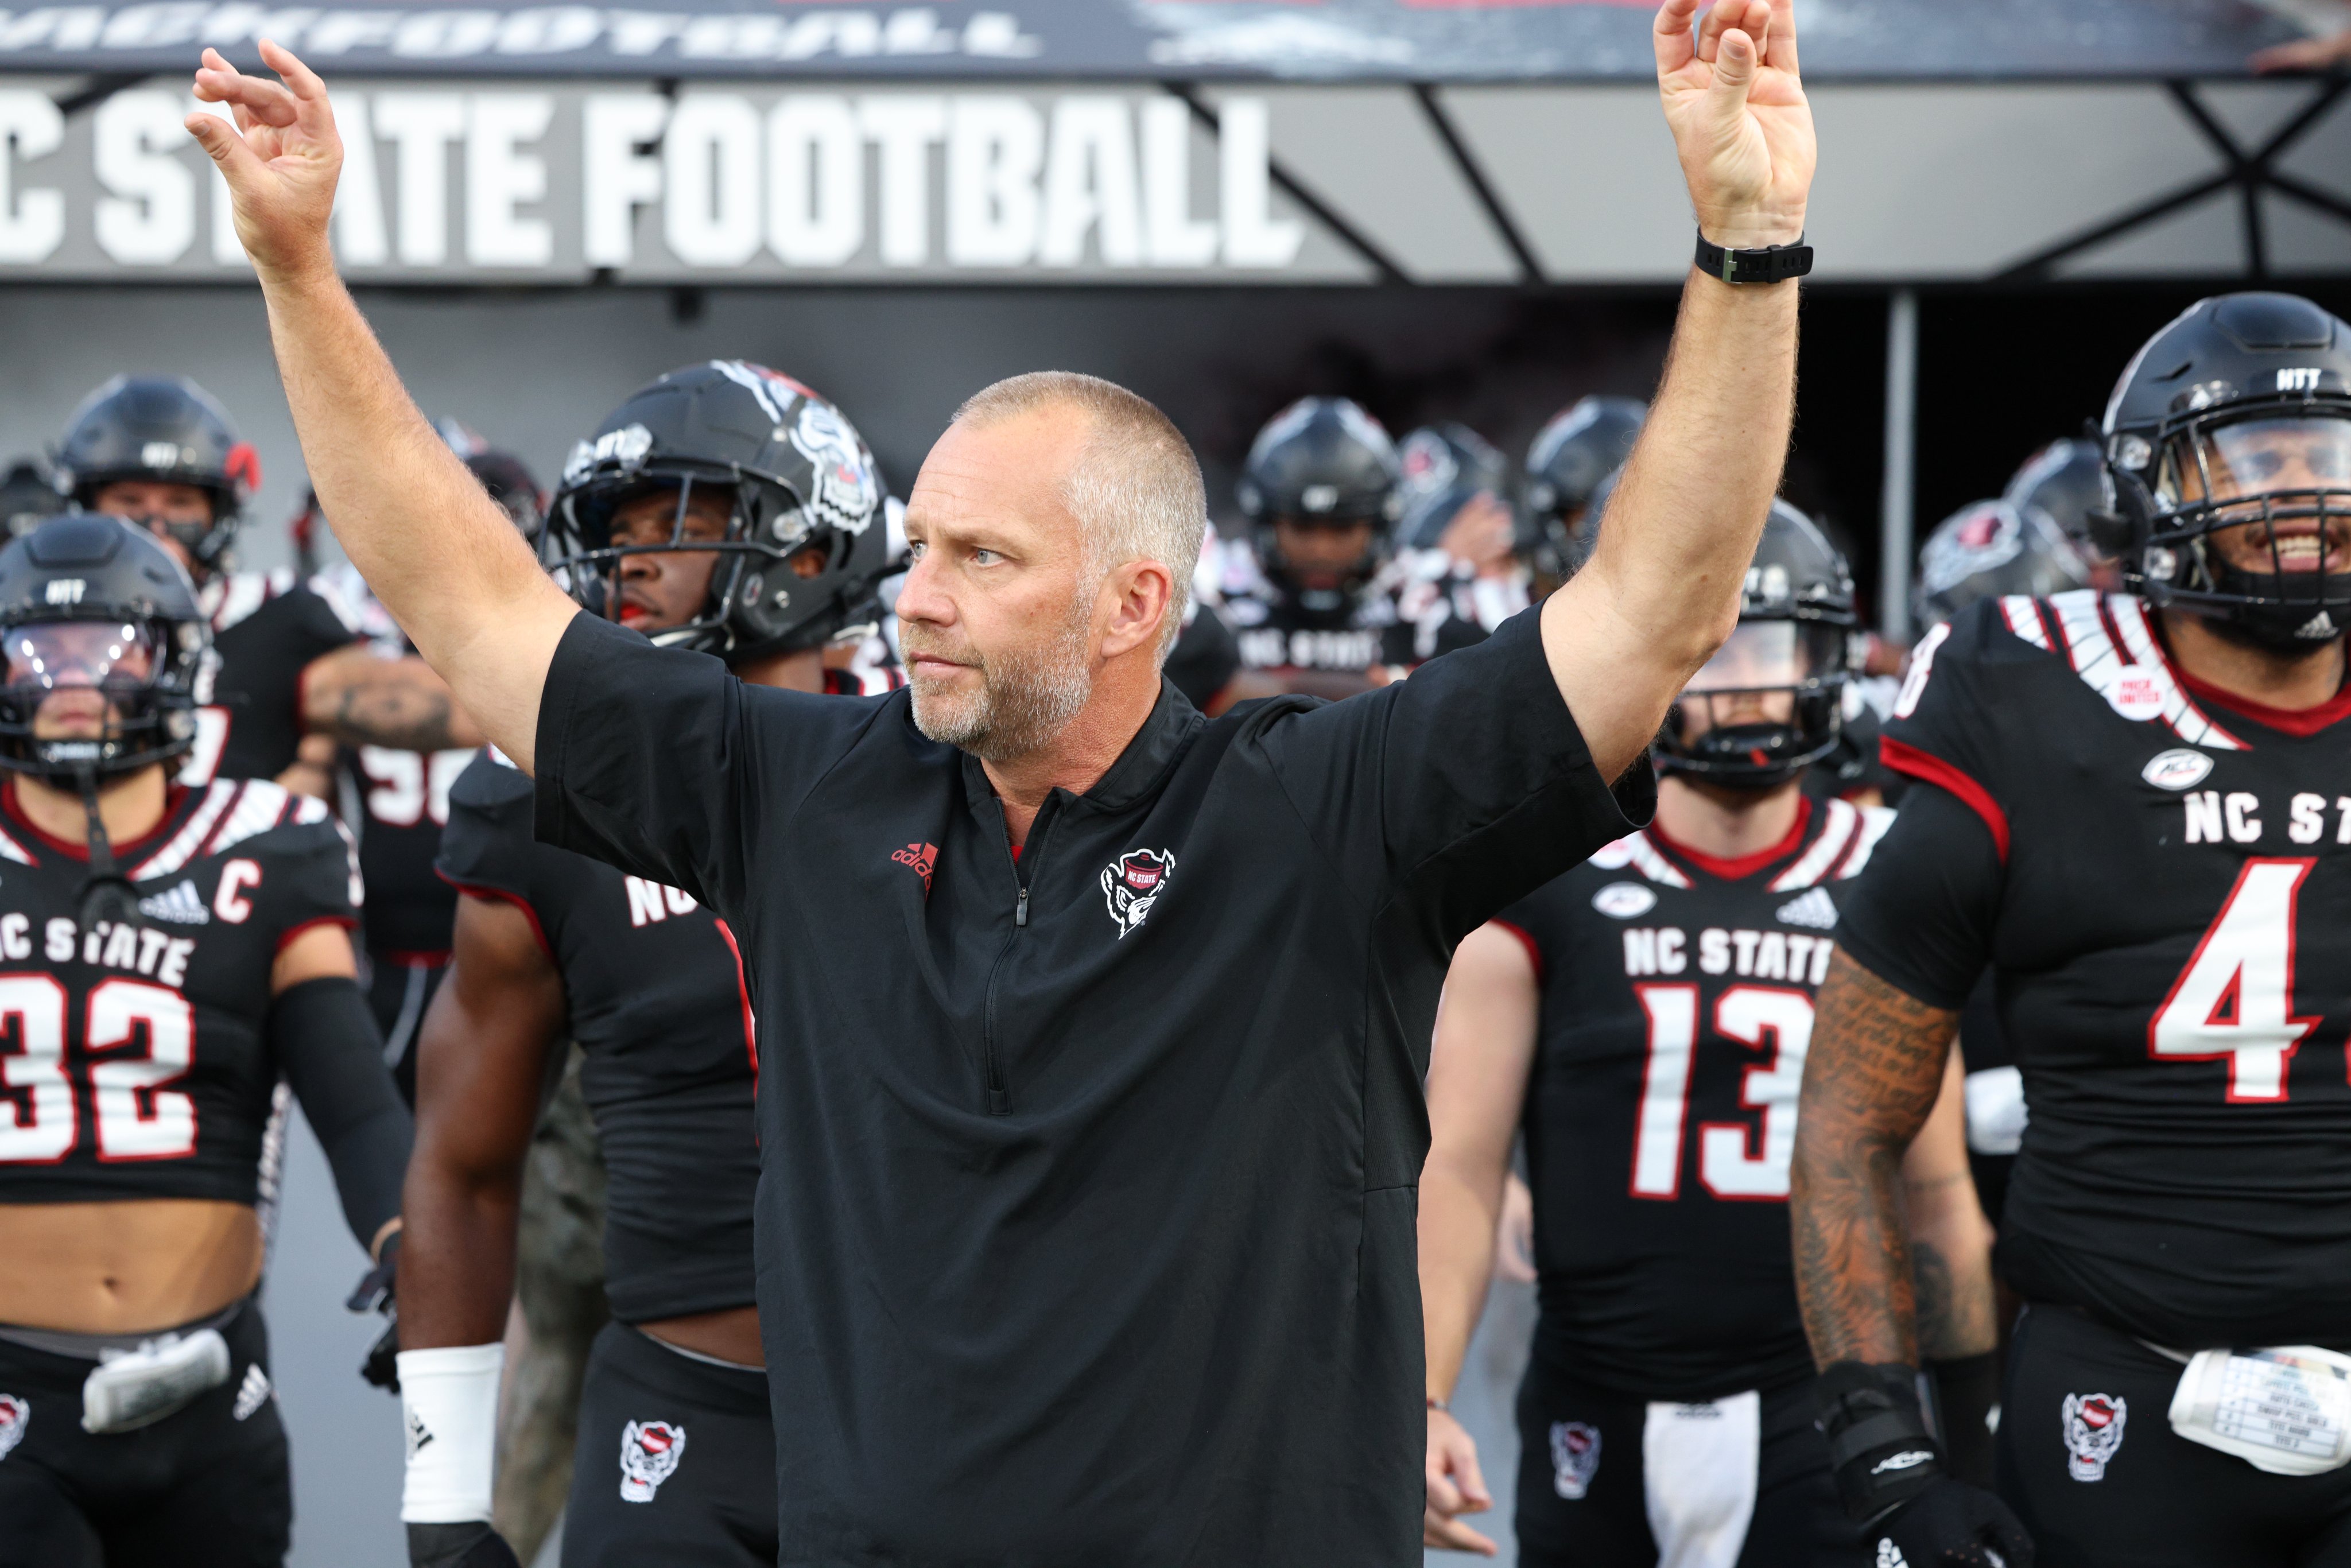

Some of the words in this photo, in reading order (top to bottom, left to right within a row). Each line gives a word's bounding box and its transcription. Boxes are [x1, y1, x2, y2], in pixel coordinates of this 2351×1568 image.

[581, 90, 1306, 269] FOOTBALL
[2276, 367, 2322, 391] HTT
[2183, 790, 2263, 844] NC
[213, 858, 263, 924] C
[1127, 870, 1137, 882] NC
[1136, 874, 1157, 884] STATE
[0, 912, 32, 962] C
[1623, 926, 1688, 976] NC
[2147, 856, 2351, 1104] 4
[0, 972, 199, 1165] 32
[1628, 981, 1815, 1201] 13
